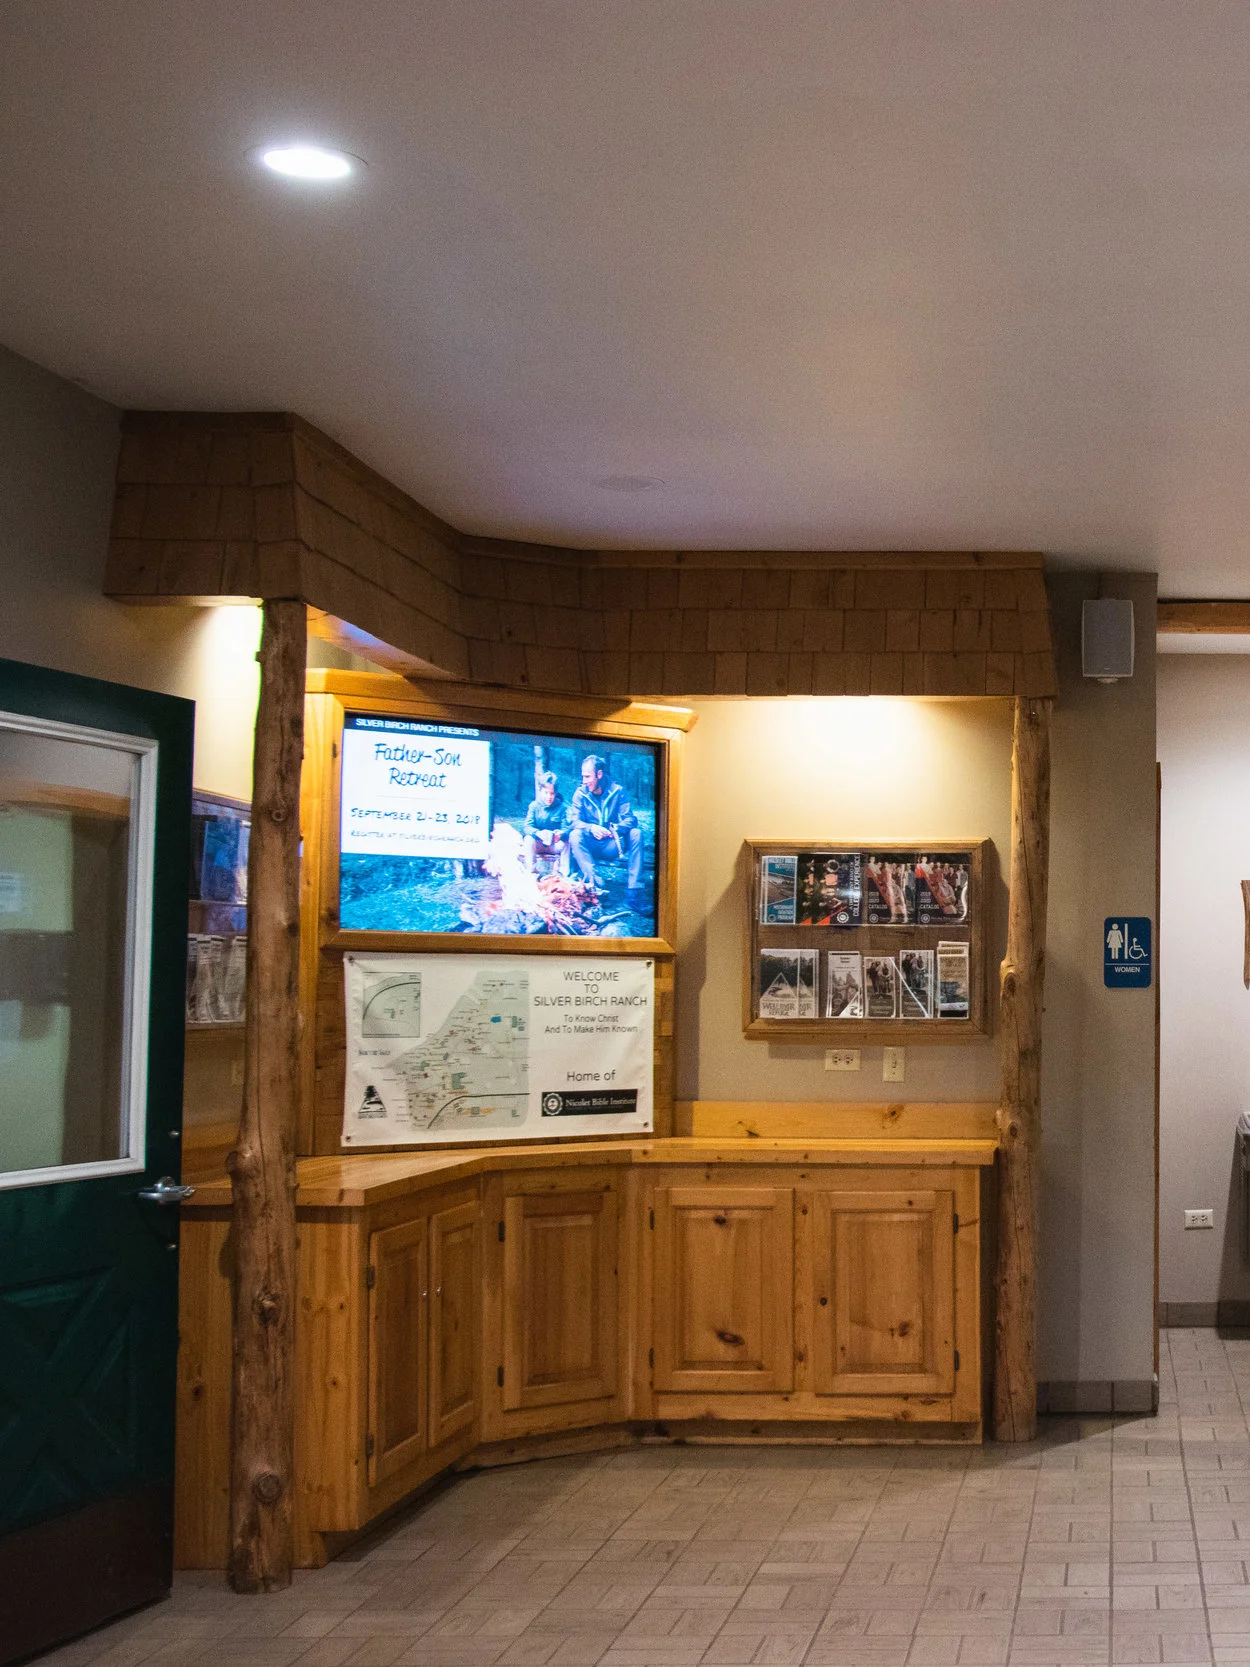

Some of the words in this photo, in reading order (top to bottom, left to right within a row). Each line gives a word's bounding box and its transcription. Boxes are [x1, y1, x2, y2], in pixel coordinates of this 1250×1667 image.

[356, 718, 384, 728] SILVER
[385, 720, 410, 730] BIRCH
[410, 722, 438, 732] RANCH
[439, 725, 480, 737] PRESENTS
[375, 743, 462, 766] Father-Son
[389, 767, 448, 788] Retreat
[351, 808, 411, 821] SEPTEMBER
[563, 971, 620, 982] WELCOME
[584, 983, 600, 994] TO
[533, 996, 572, 1007] SILVER
[575, 996, 608, 1007] BIRCH
[610, 996, 648, 1007] RANCH
[564, 1014, 574, 1023] To
[575, 1014, 597, 1023] Know
[598, 1014, 619, 1023] Christ
[545, 1025, 560, 1034] And
[562, 1025, 572, 1033] To
[573, 1025, 595, 1033] Make
[596, 1025, 610, 1033] Him
[611, 1025, 638, 1033] Known
[566, 1071, 600, 1082] Home
[603, 1069, 616, 1081] of
[592, 1097, 609, 1106] Bible
